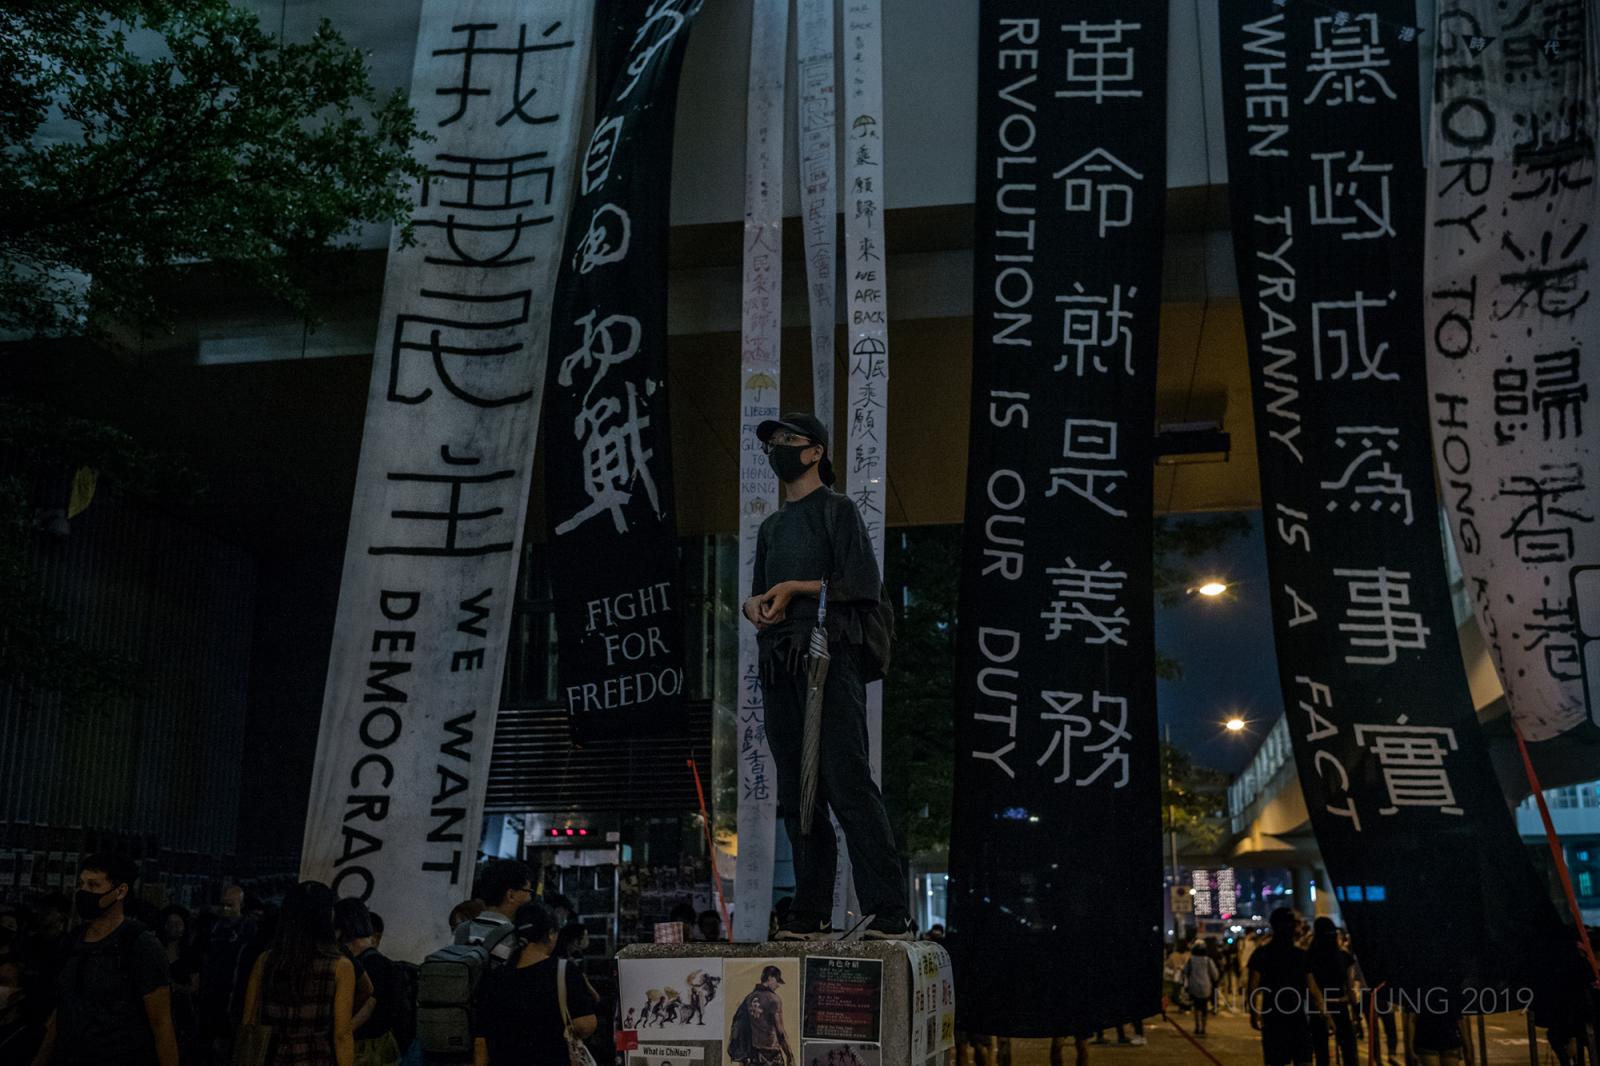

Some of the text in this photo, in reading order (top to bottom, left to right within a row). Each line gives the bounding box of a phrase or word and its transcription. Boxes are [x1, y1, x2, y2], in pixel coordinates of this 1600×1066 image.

[854, 289, 881, 302] ARE
[855, 271, 877, 281] WE
[854, 311, 885, 325] BACK
[1432, 276, 1476, 359] TO
[971, 18, 1040, 779] REVOLUTION IS OUR DUTY
[1241, 13, 1361, 832] WHEN TYRANNY IS A FACT
[1435, 393, 1480, 556] HONG
[585, 582, 673, 632] FIGHT
[603, 626, 671, 667] FOR
[422, 587, 492, 885] WE WANT
[643, 1047, 659, 1056] What
